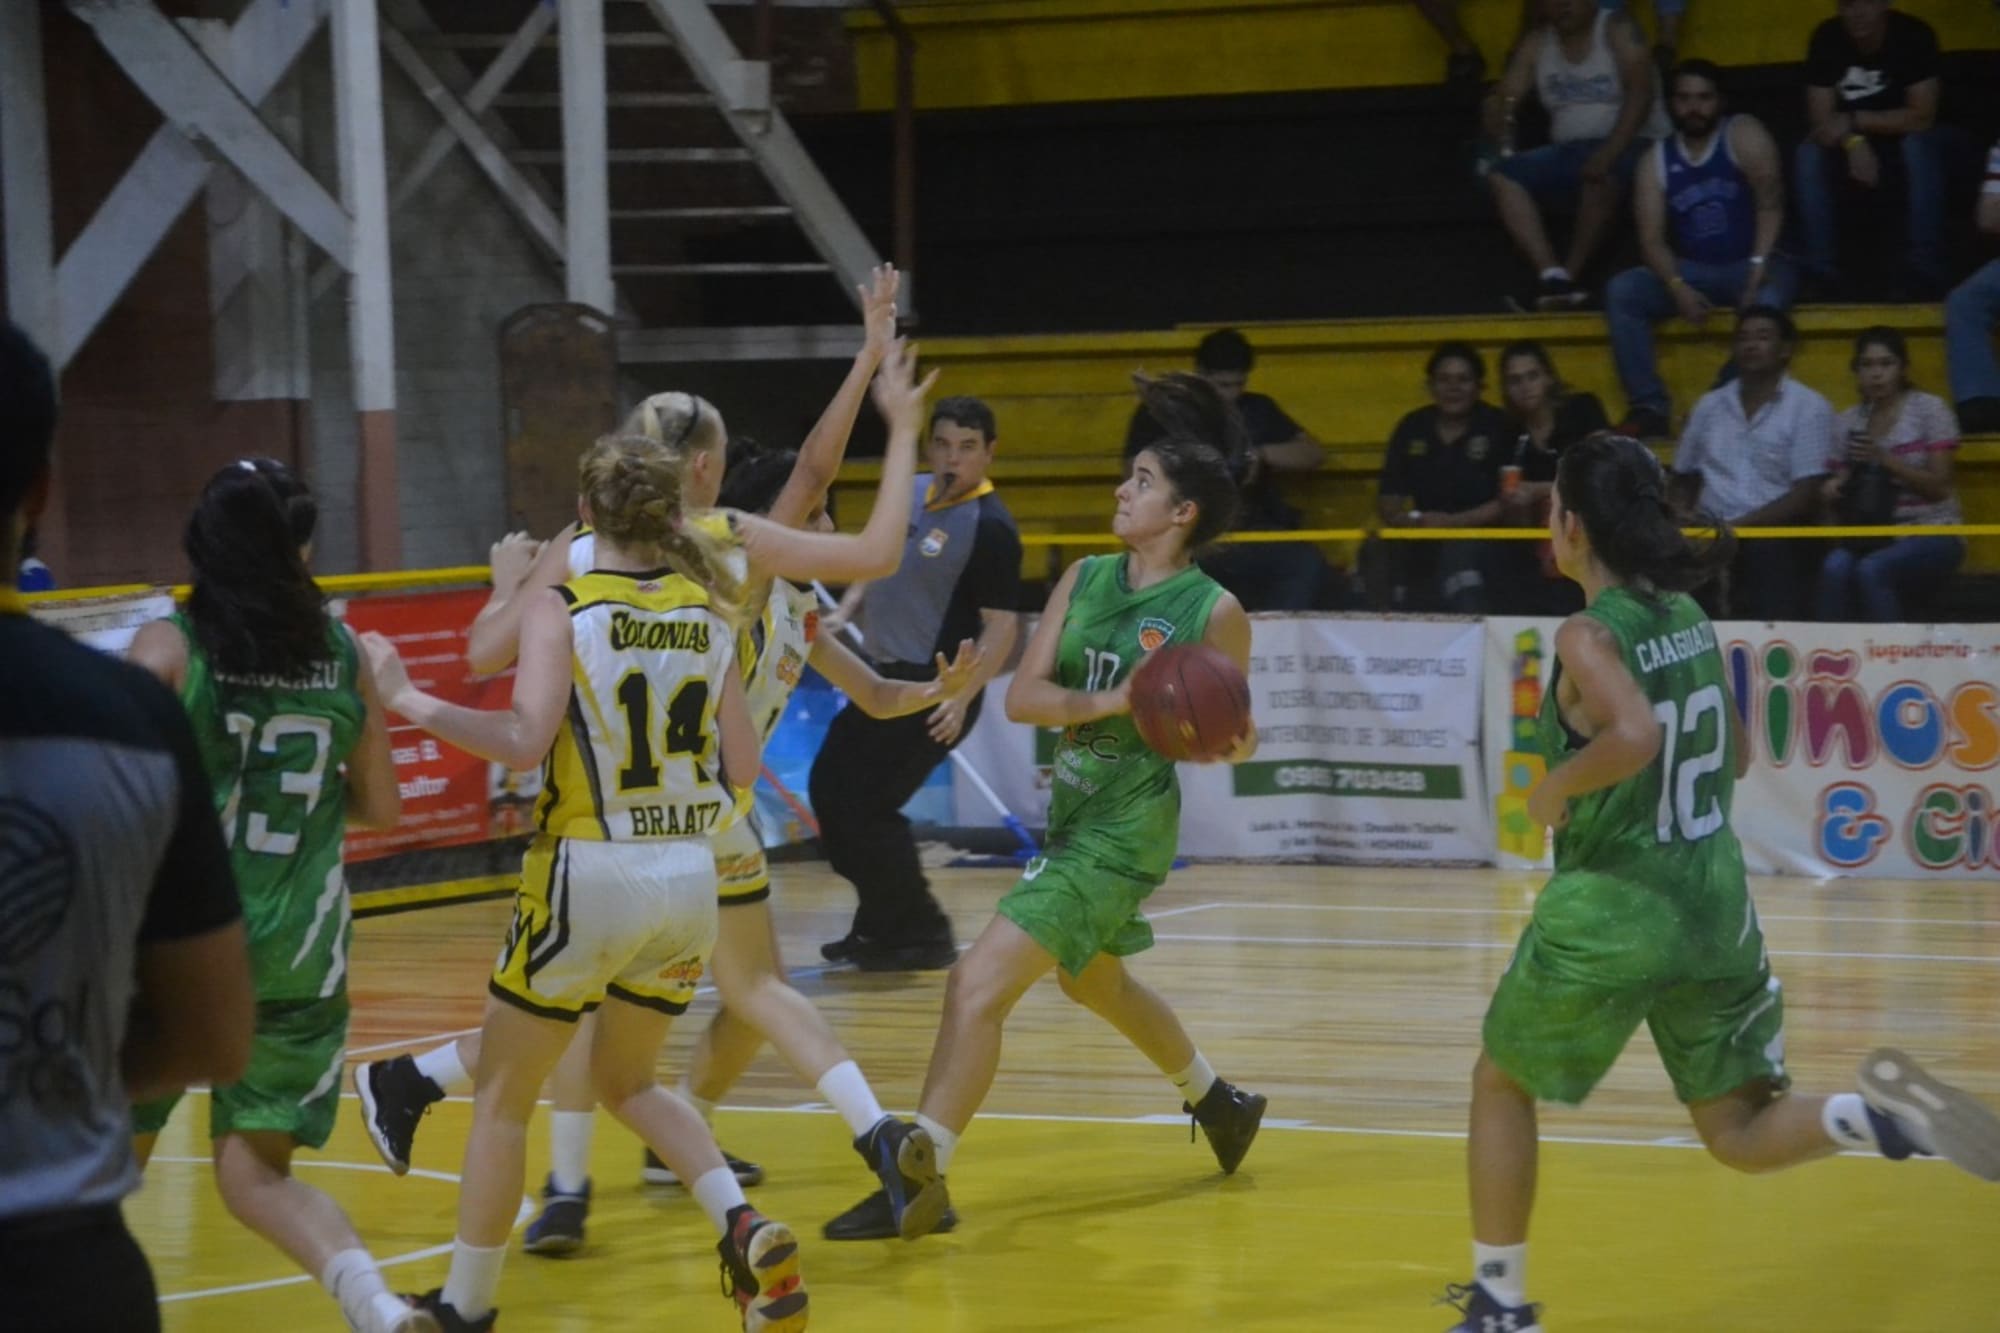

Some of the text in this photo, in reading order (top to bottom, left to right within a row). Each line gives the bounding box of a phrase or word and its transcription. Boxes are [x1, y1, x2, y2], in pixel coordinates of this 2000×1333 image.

[220, 712, 333, 856] 13
[613, 666, 717, 796] 14
[1653, 683, 1726, 844] 12
